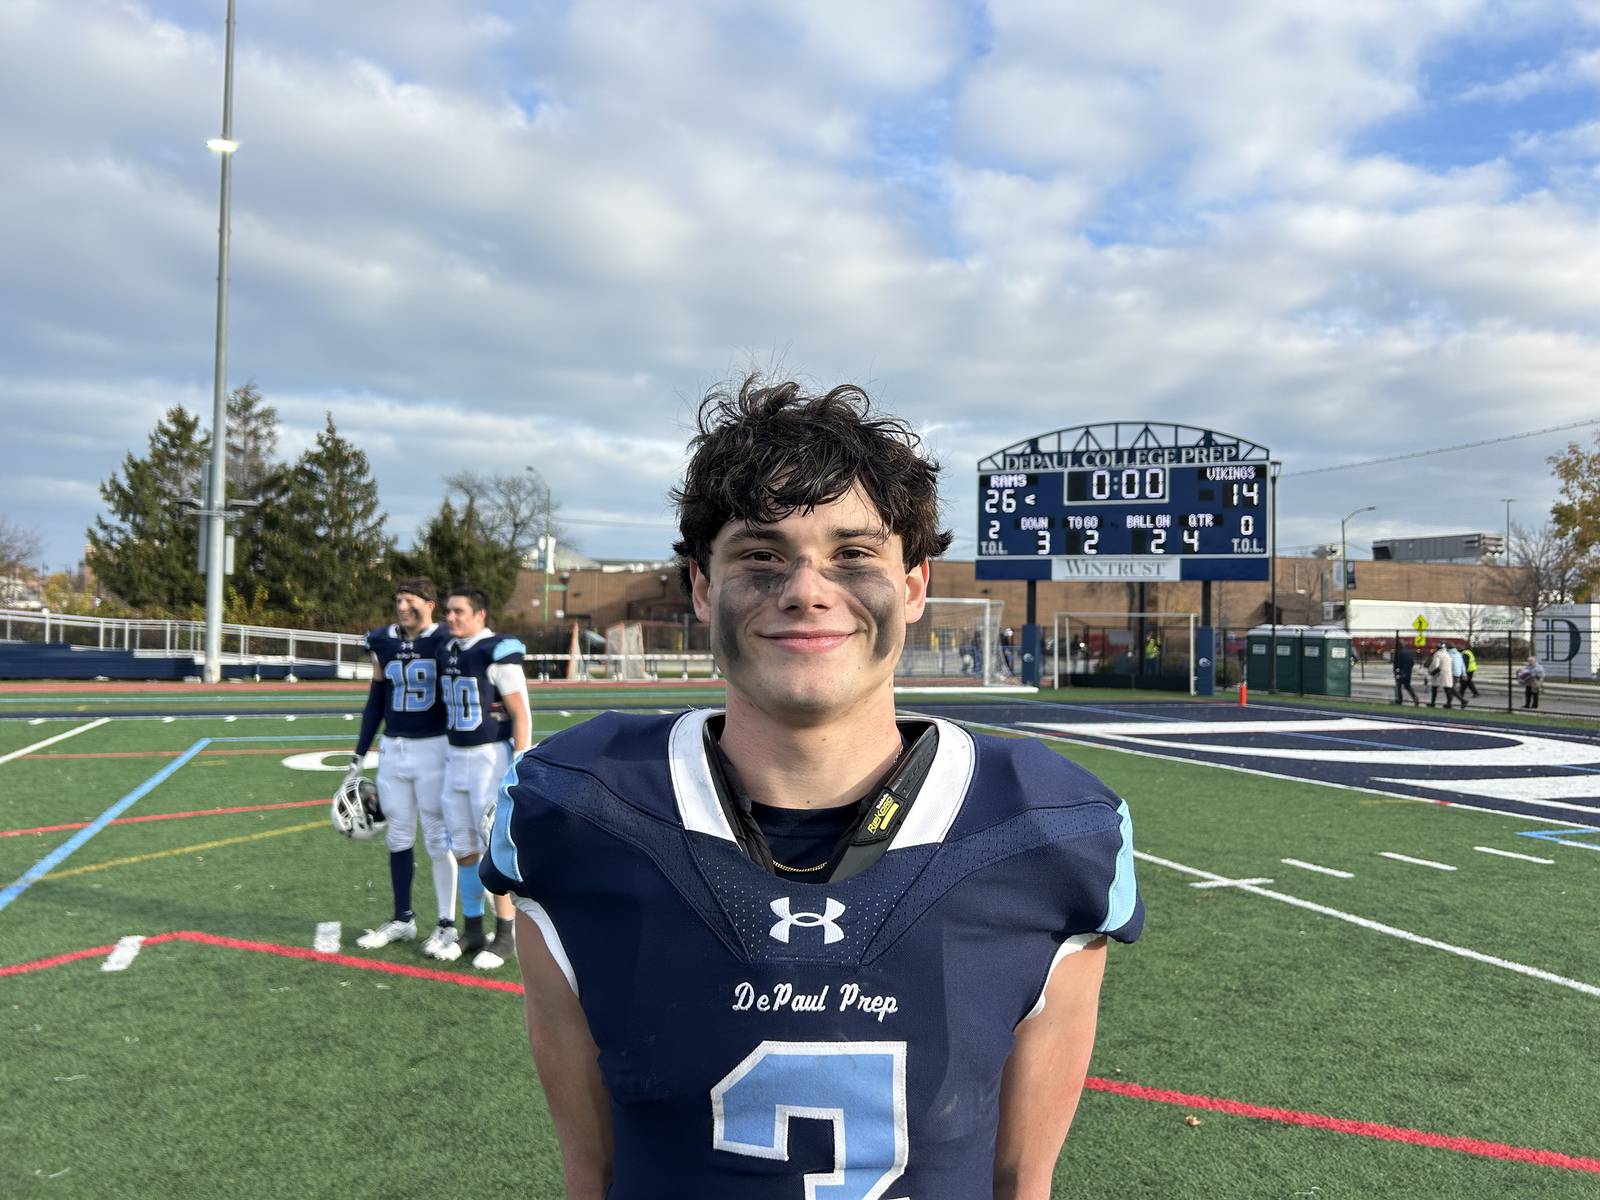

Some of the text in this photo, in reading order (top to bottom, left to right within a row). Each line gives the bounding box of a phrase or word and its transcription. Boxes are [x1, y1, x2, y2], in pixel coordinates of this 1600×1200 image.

[1005, 446, 1237, 471] DEPAUL COLLEGE PREP
[990, 474, 1028, 488] RAMS
[1092, 468, 1164, 500] 0:00
[1206, 466, 1256, 481] VIKINGS
[985, 489, 1017, 514] 26
[1232, 482, 1259, 507] 14
[988, 520, 1001, 540] 2
[1020, 516, 1049, 530] DOWN
[1126, 514, 1172, 529] BALL ON
[1188, 513, 1214, 527] QTR
[1240, 515, 1254, 536] 0
[980, 541, 1008, 555] T.O.L.
[1037, 530, 1051, 555] 3
[1083, 530, 1099, 555] 2
[1150, 529, 1167, 554] 2
[1183, 529, 1200, 552] 4
[1232, 538, 1264, 553] T.O.L.
[1065, 559, 1165, 577] WINTRUST
[1541, 618, 1582, 662] D
[384, 658, 437, 712] 19
[732, 982, 898, 1022] DePaul Prep
